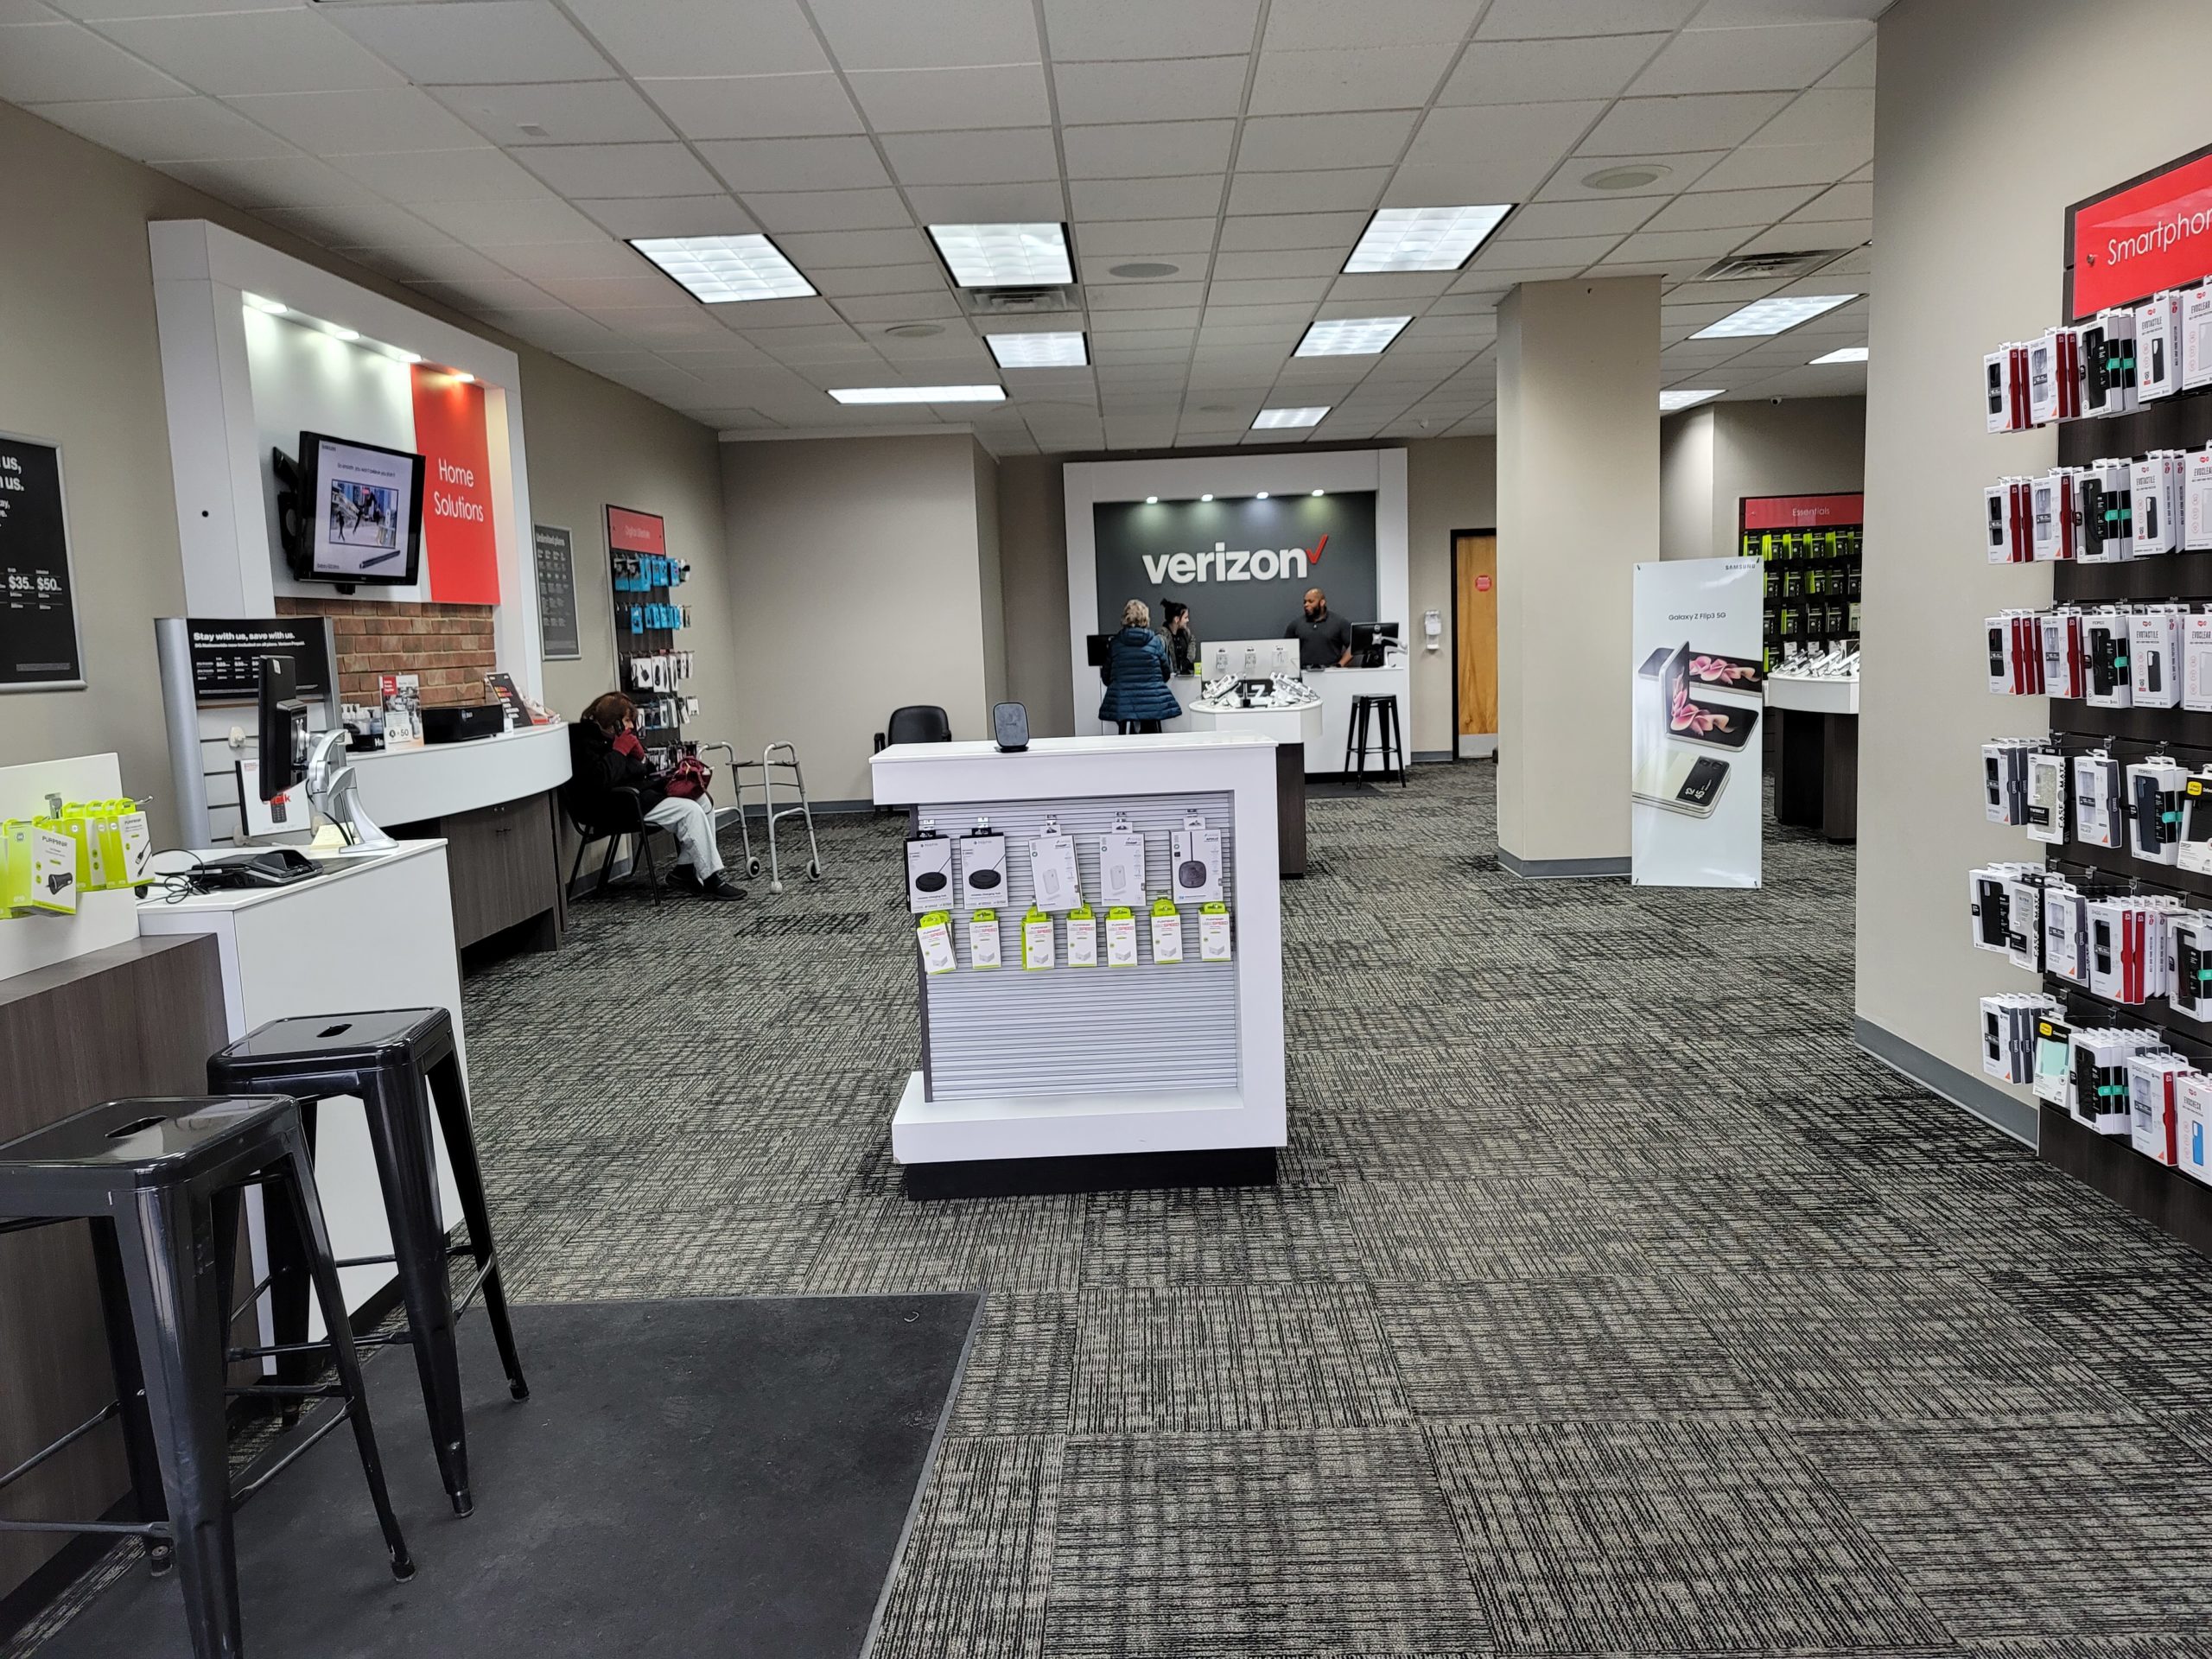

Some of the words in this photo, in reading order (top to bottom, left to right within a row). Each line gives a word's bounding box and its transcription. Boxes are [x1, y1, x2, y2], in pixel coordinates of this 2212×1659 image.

[2, 456, 22, 474] us,
[439, 457, 474, 487] Home
[5, 476, 24, 491] us.
[434, 491, 484, 522] Solutions
[1792, 507, 1830, 517] Essentials
[1141, 542, 1307, 584] verizon
[1669, 613, 1694, 621] Galaxy
[194, 632, 214, 642] Stay
[216, 632, 235, 640] with
